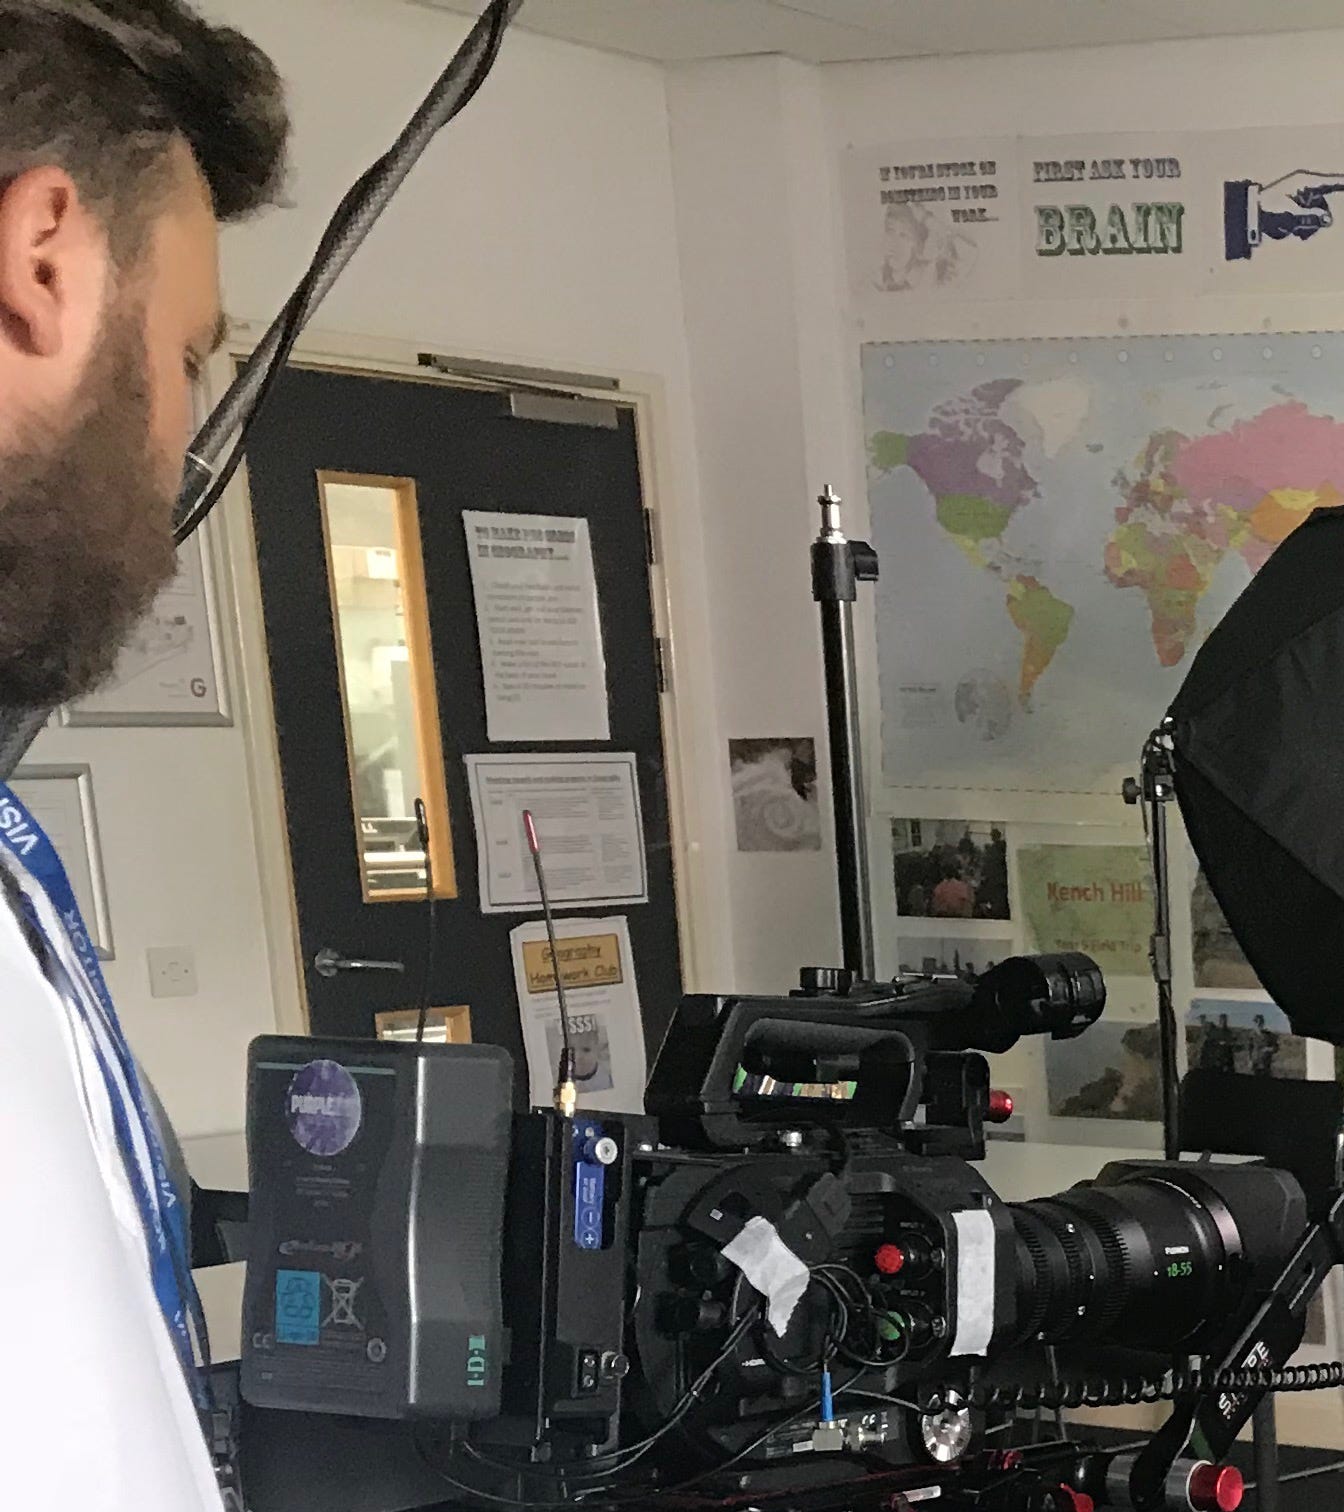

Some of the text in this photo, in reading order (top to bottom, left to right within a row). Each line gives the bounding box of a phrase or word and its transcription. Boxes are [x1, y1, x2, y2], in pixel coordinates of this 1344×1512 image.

[1033, 157, 1181, 183] FIRST ASK YOUR
[1033, 202, 1185, 257] BRAIN
[1047, 882, 1142, 903] Kench Hill
[1167, 1261, 1192, 1277] 18-55
